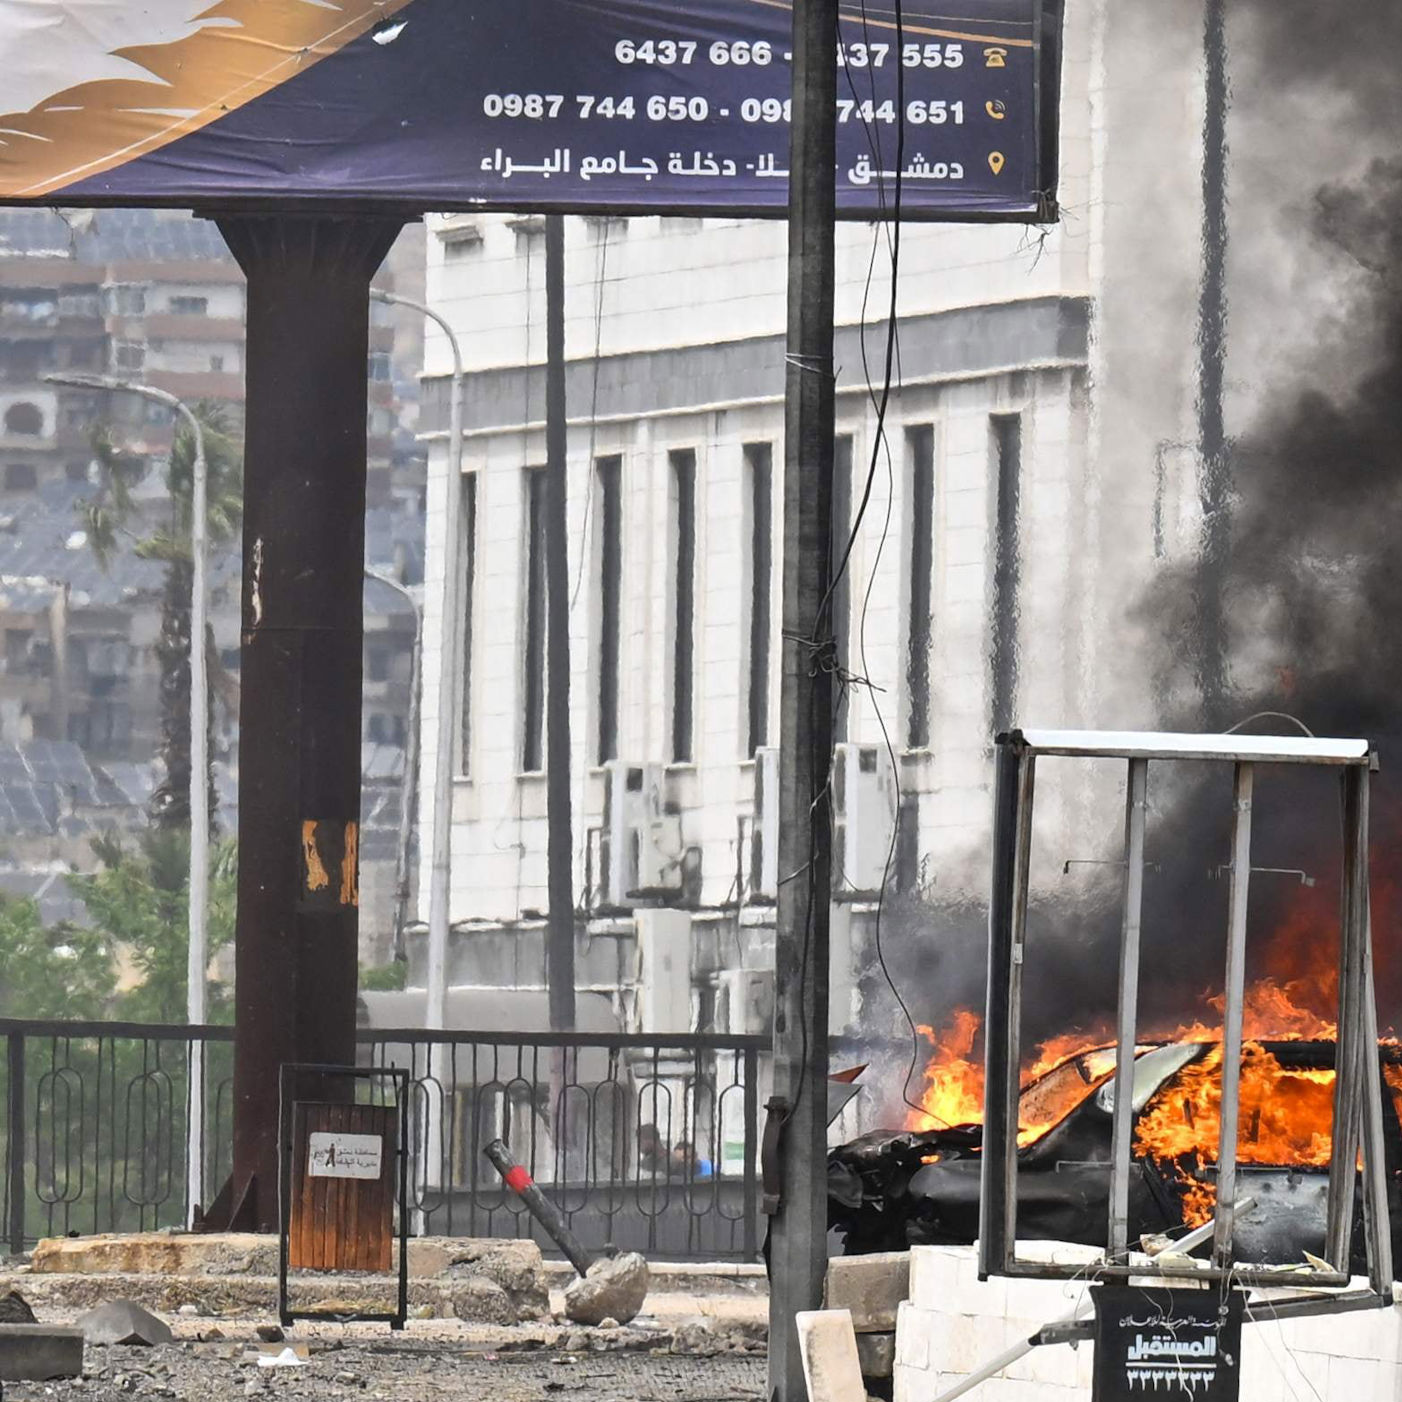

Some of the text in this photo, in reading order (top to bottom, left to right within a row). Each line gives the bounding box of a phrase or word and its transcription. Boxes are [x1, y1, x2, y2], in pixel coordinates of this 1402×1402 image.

[615, 40, 697, 65] 6437
[709, 41, 772, 66] 666
[902, 44, 964, 68] 555
[483, 94, 564, 118] 0987
[576, 96, 636, 119] 744
[646, 96, 708, 122] 650
[837, 99, 896, 124] 744
[906, 100, 964, 125] 651
[480, 148, 570, 178] البراء
[580, 150, 659, 181] جامع
[668, 151, 737, 176] دخلة
[1127, 1333, 1217, 1360] المستقبل
